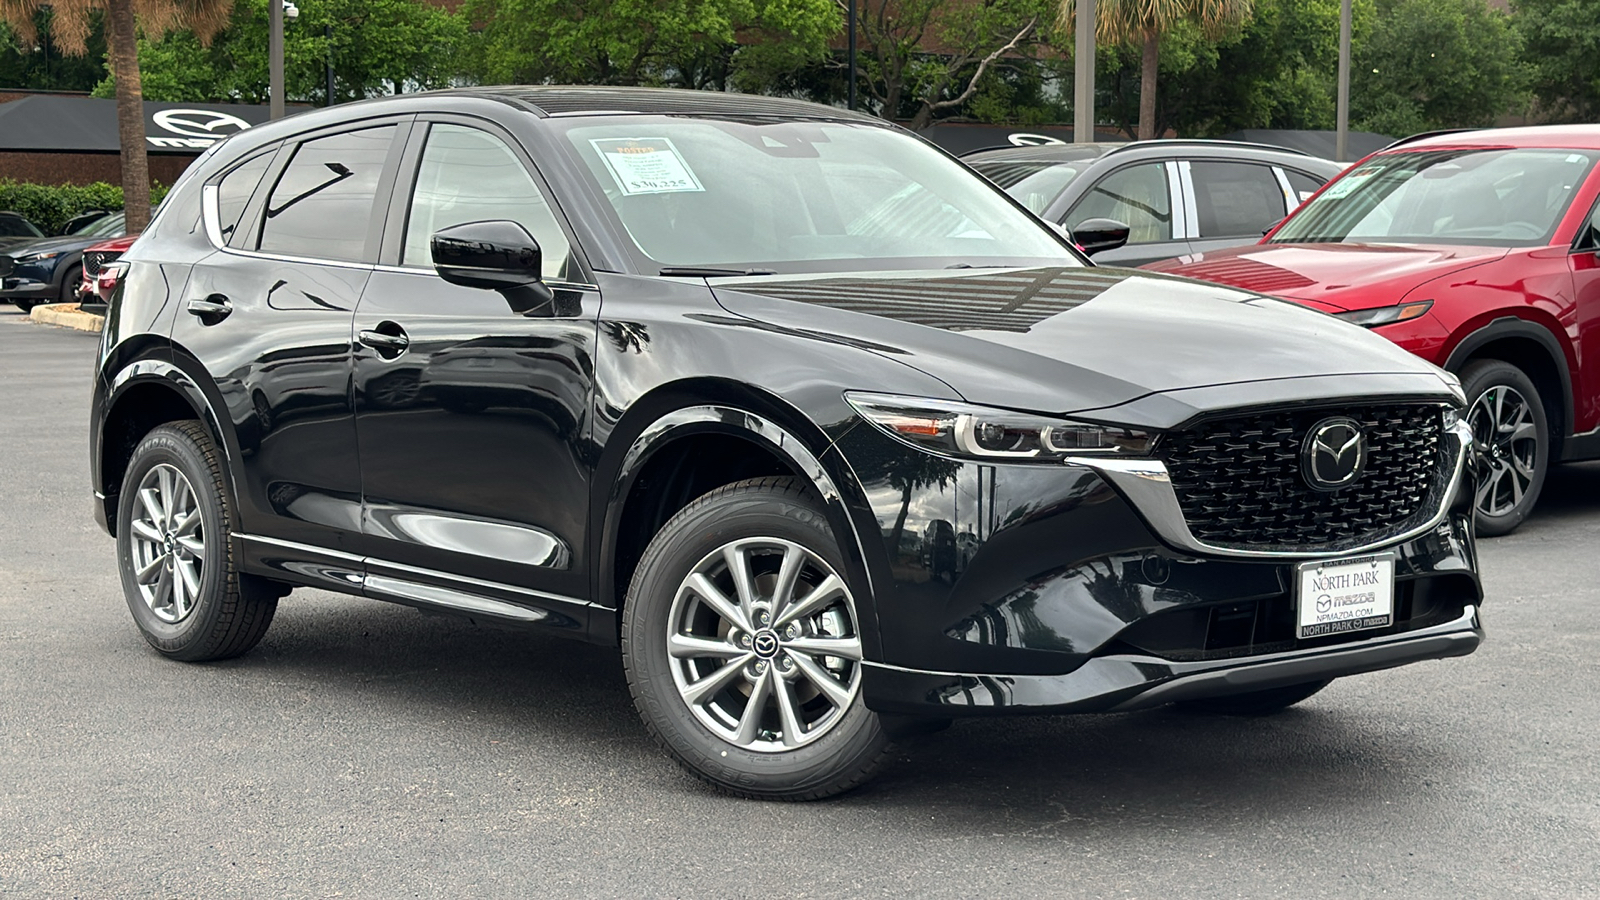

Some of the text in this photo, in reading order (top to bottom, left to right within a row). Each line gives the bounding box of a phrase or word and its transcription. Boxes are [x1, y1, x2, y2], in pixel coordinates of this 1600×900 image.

[1340, 557, 1373, 565] ANTONIO
[1312, 570, 1379, 592] NORTH PARK
[1334, 592, 1375, 607] mazda
[1303, 616, 1388, 636] NORTH PARK mazda
